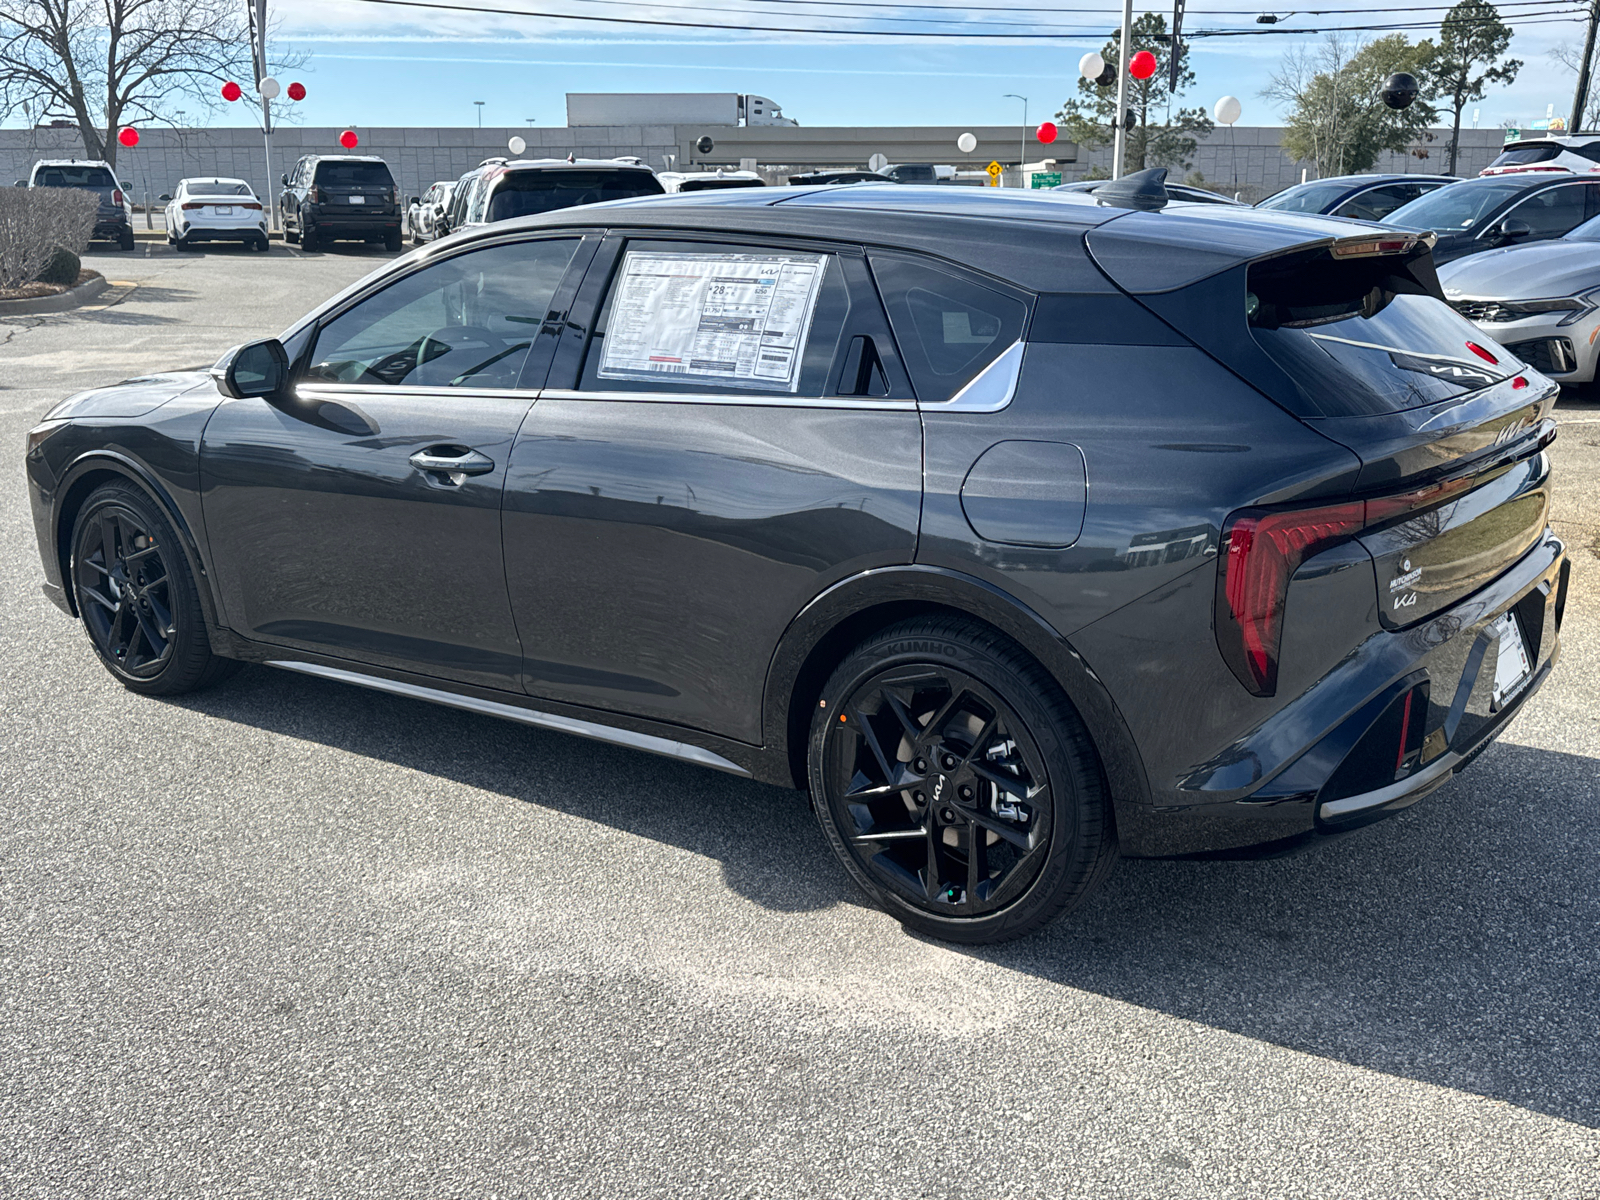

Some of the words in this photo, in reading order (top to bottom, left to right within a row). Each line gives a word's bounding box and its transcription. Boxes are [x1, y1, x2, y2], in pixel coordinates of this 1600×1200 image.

[713, 285, 725, 295] 28
[1389, 567, 1423, 589] HUTCHINSON
[1393, 591, 1417, 610] K4
[887, 641, 958, 657] KUMHO
